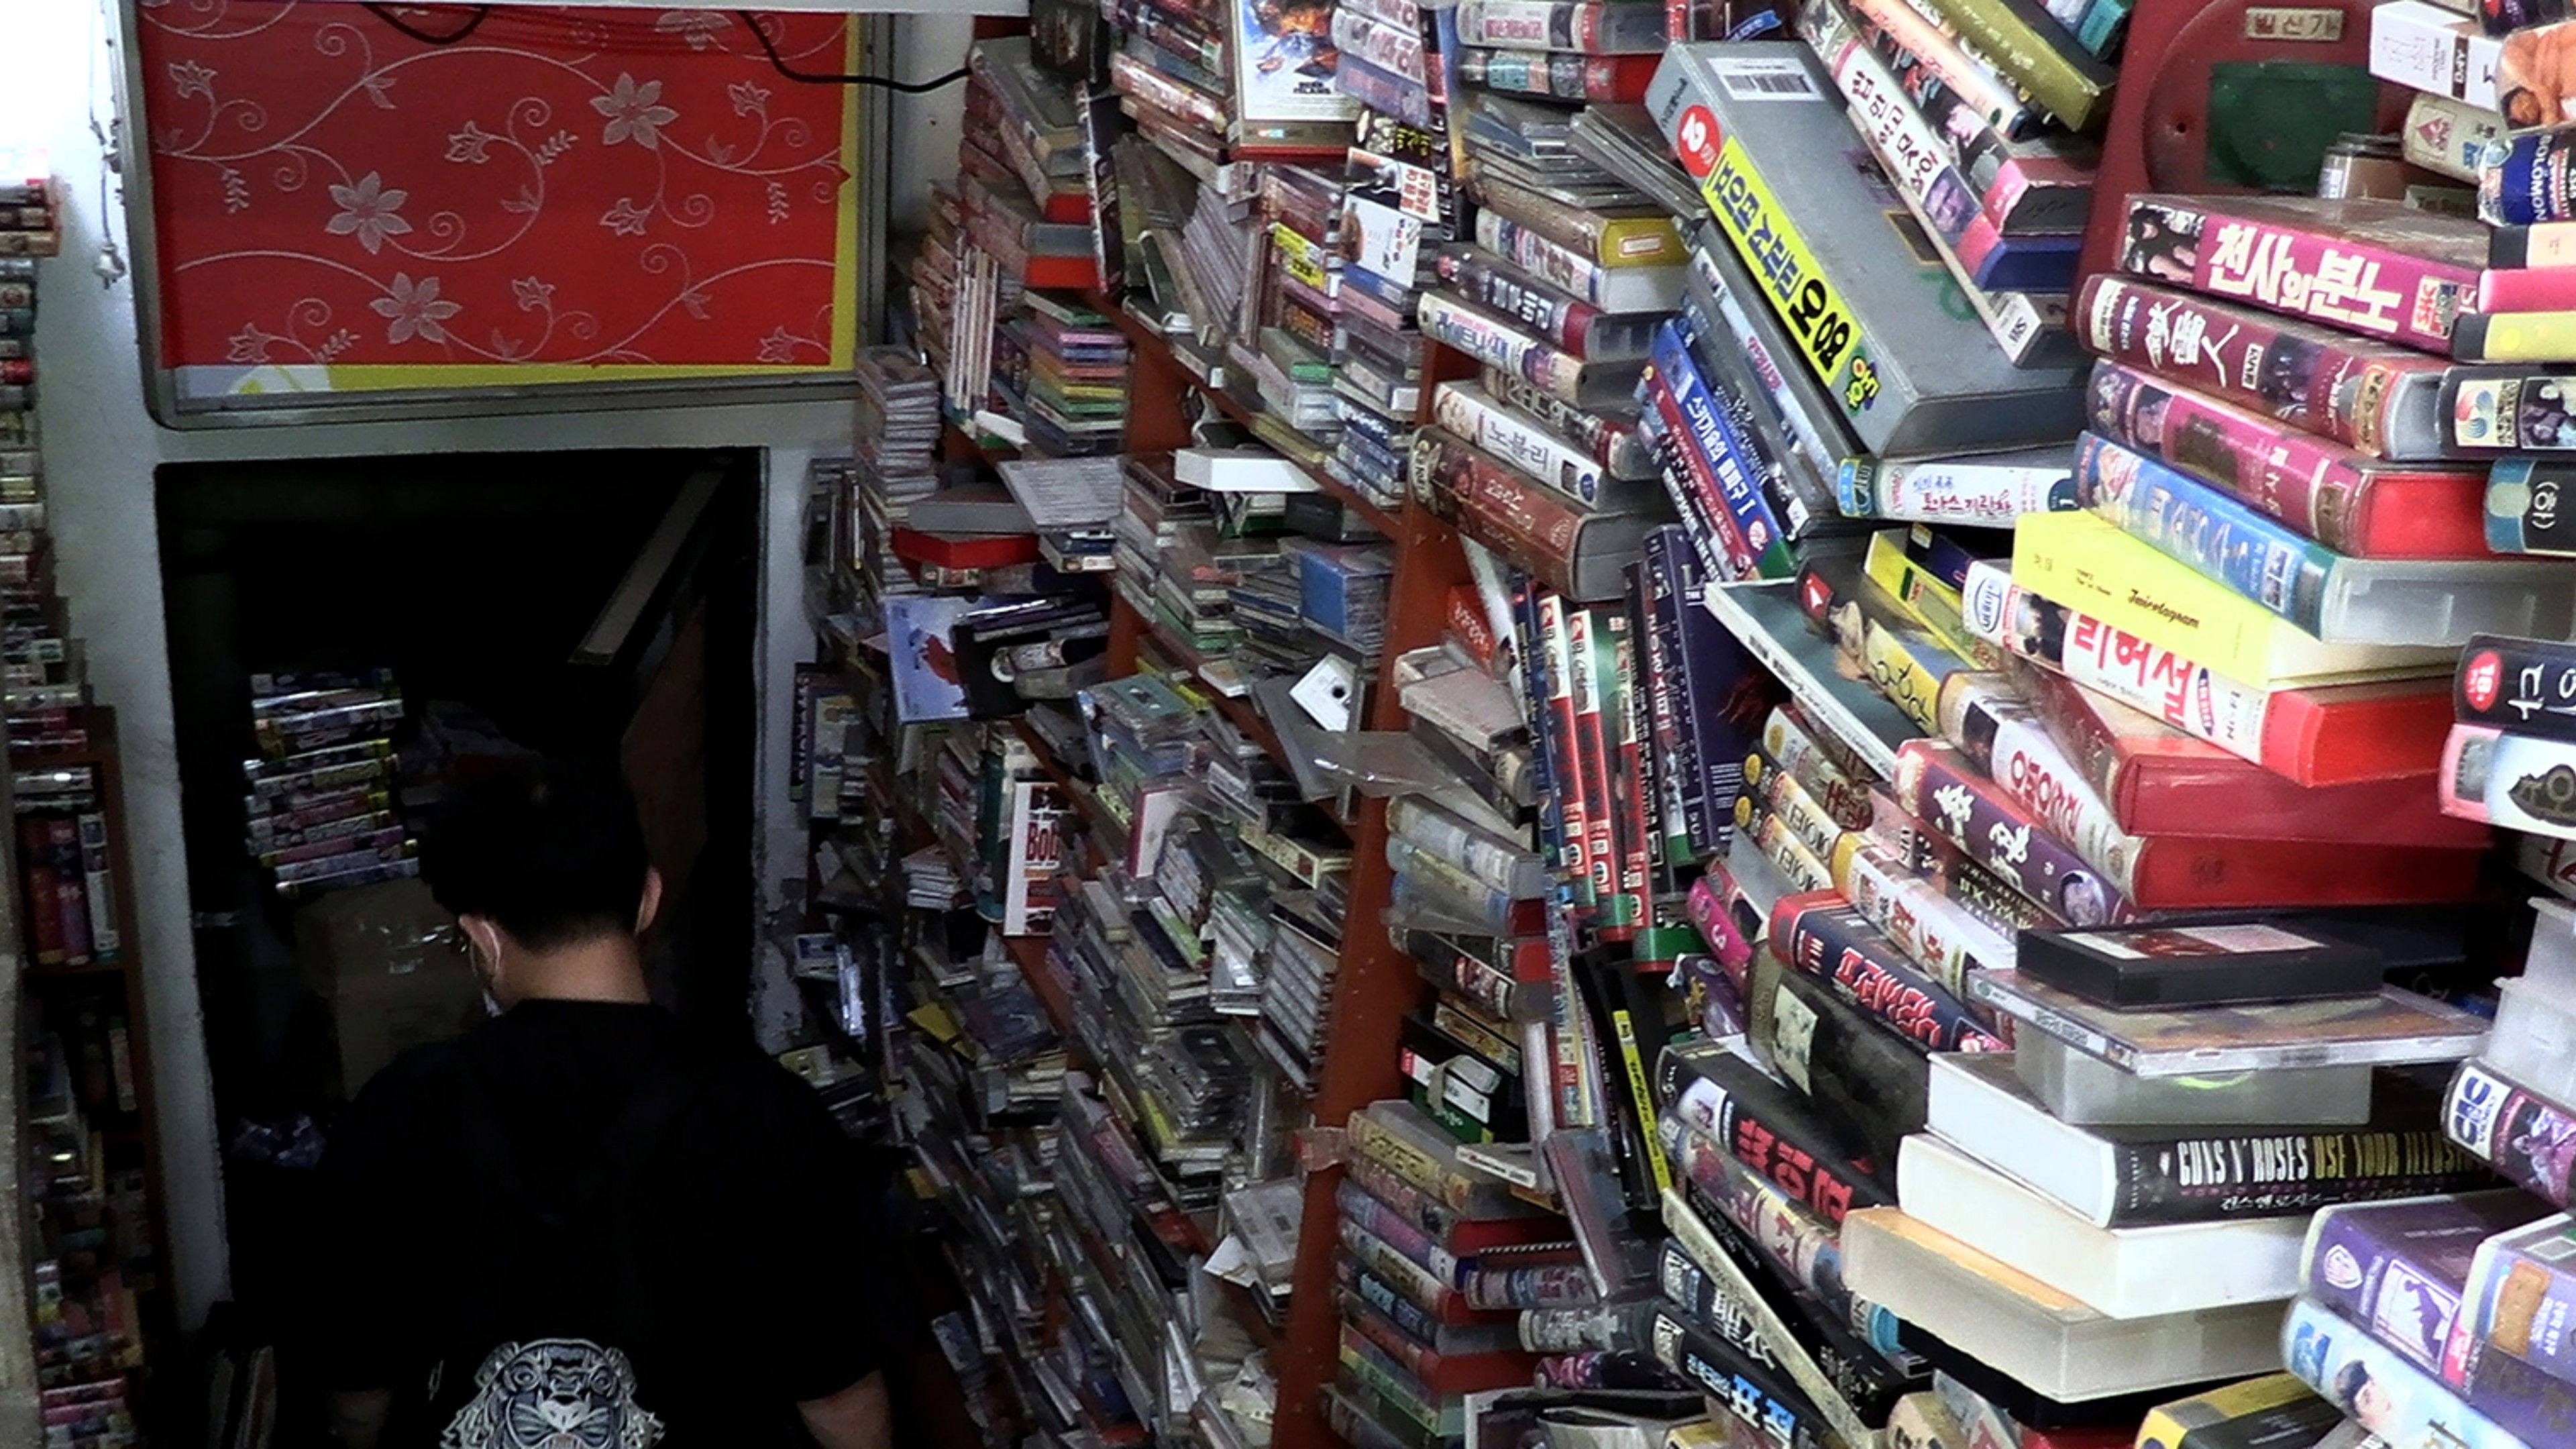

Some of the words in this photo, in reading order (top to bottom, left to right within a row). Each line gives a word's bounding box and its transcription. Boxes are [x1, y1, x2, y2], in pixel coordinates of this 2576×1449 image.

[2252, 10, 2338, 38] 발신기
[1744, 212, 1803, 299] 교과서
[1790, 277, 1851, 374] 영어
[2178, 1139, 2226, 1187] GUNS
[2251, 1136, 2309, 1181] ROSES
[2313, 1134, 2347, 1179] USE
[2353, 1131, 2400, 1177] YOUR
